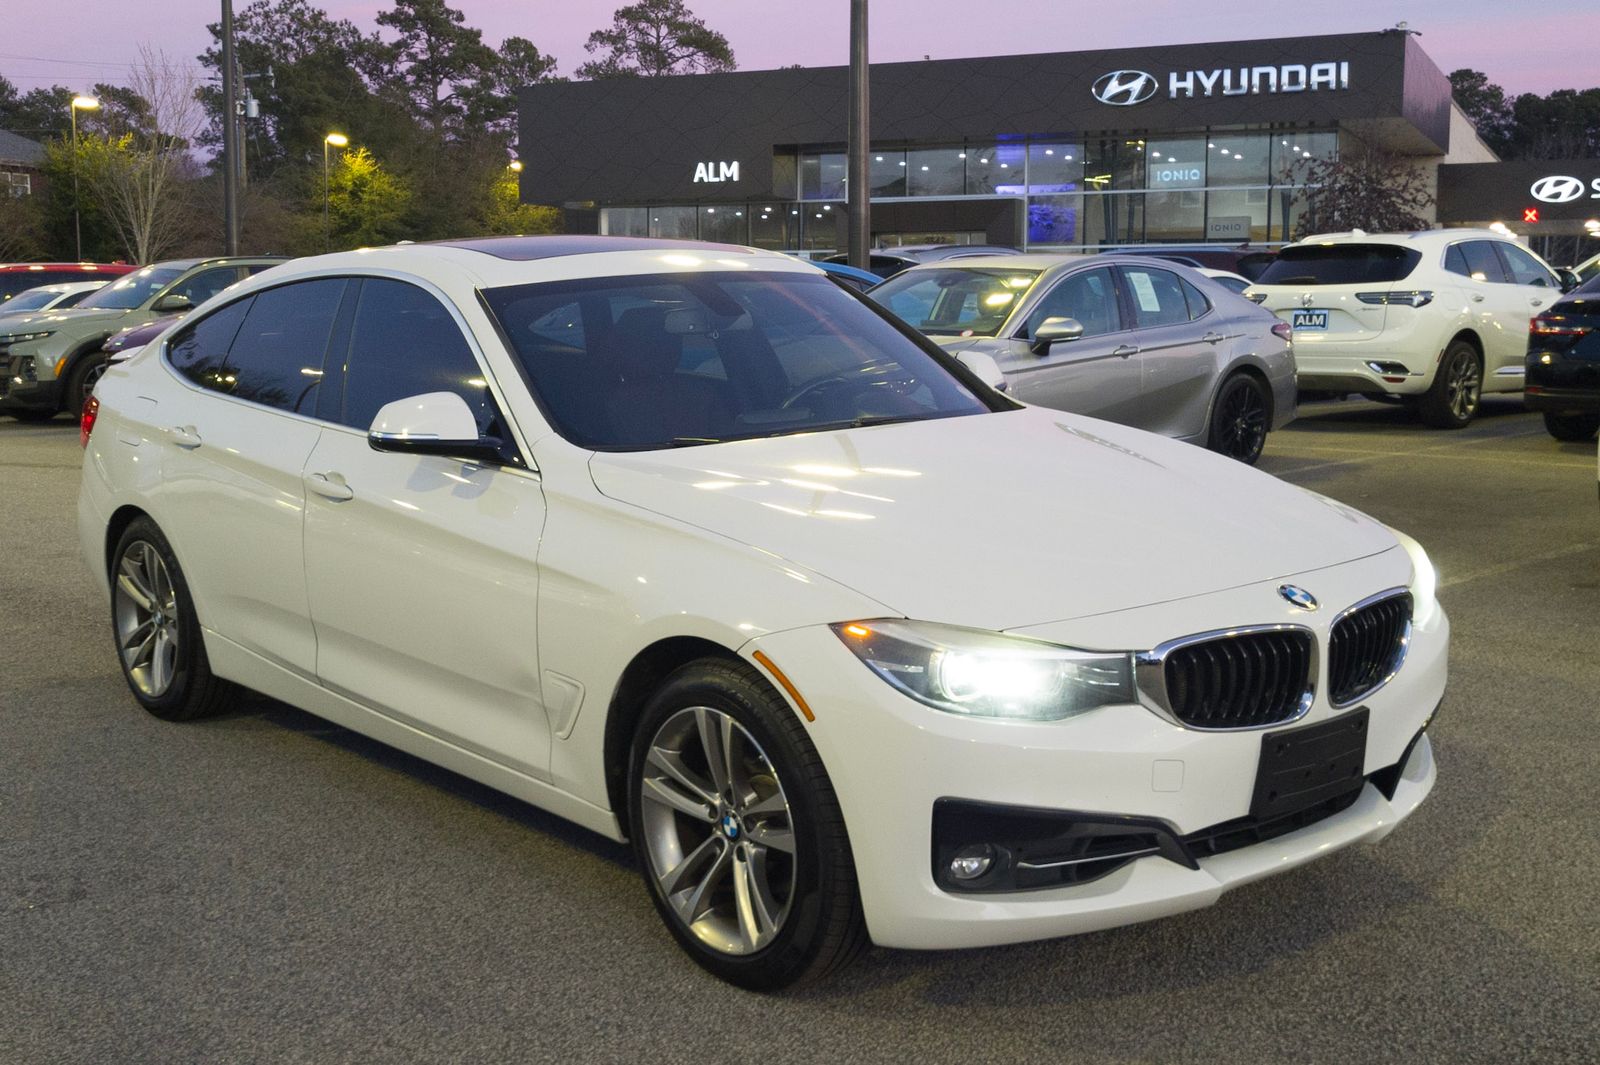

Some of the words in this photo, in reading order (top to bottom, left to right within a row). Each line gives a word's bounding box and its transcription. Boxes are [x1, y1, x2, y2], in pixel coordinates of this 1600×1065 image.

[1168, 61, 1349, 99] HYUNDAI
[693, 160, 740, 183] ALM
[1156, 169, 1200, 182] IONIQ
[1296, 314, 1325, 326] ALM
